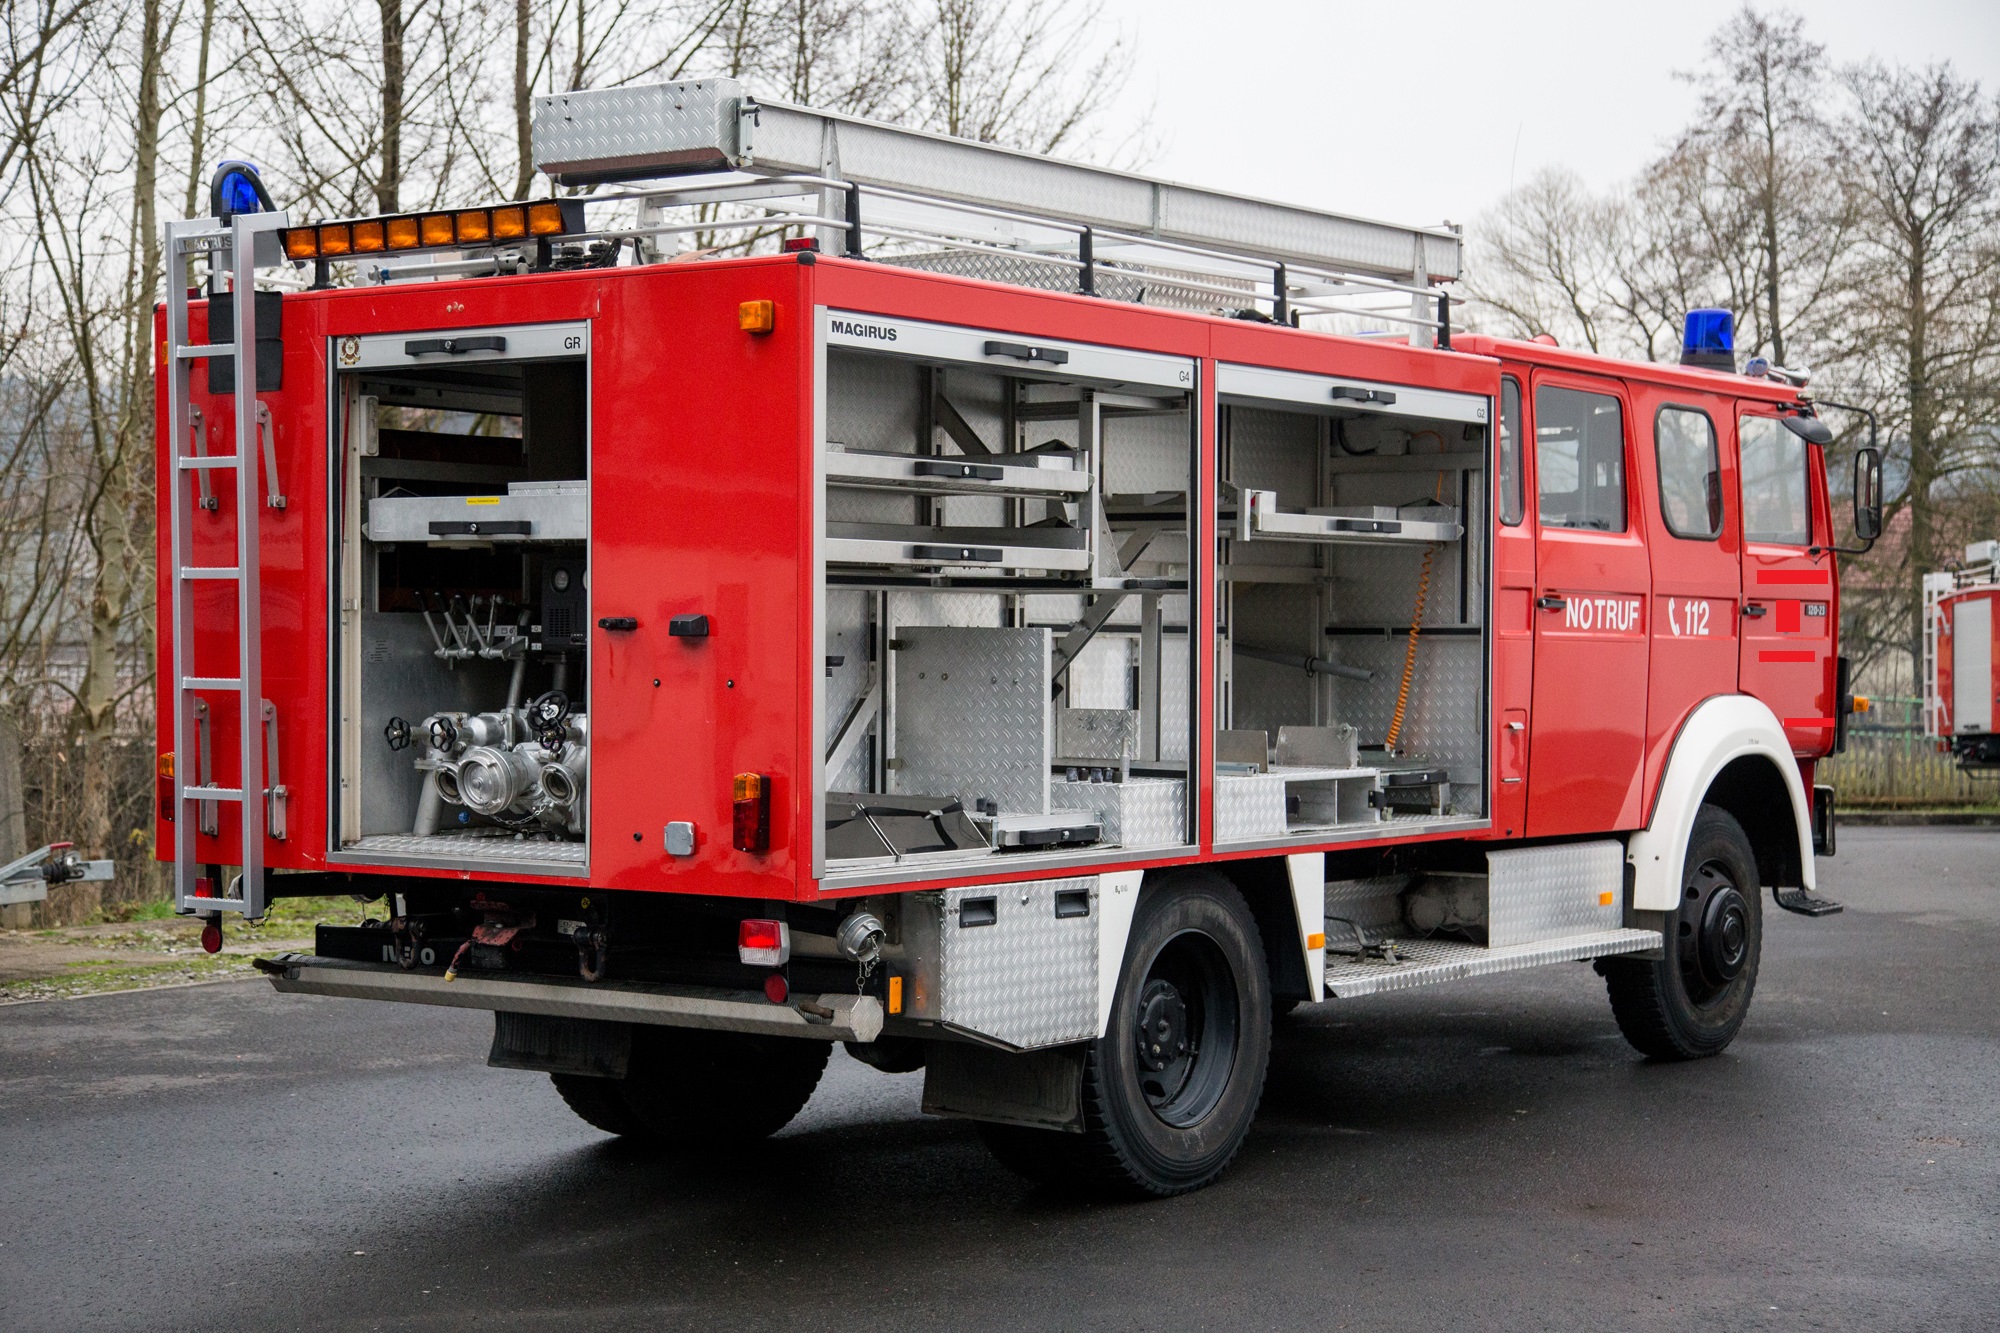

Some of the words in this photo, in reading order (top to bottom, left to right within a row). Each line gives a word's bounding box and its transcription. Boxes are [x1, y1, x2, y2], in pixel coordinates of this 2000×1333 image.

[831, 320, 897, 341] MAGIRUS
[564, 336, 581, 349] GR
[1179, 370, 1190, 382] G4
[1477, 408, 1485, 418] G2
[1565, 597, 1640, 631] NOTRUF
[1684, 600, 1710, 635] 112
[1807, 603, 1826, 616] 120-23
